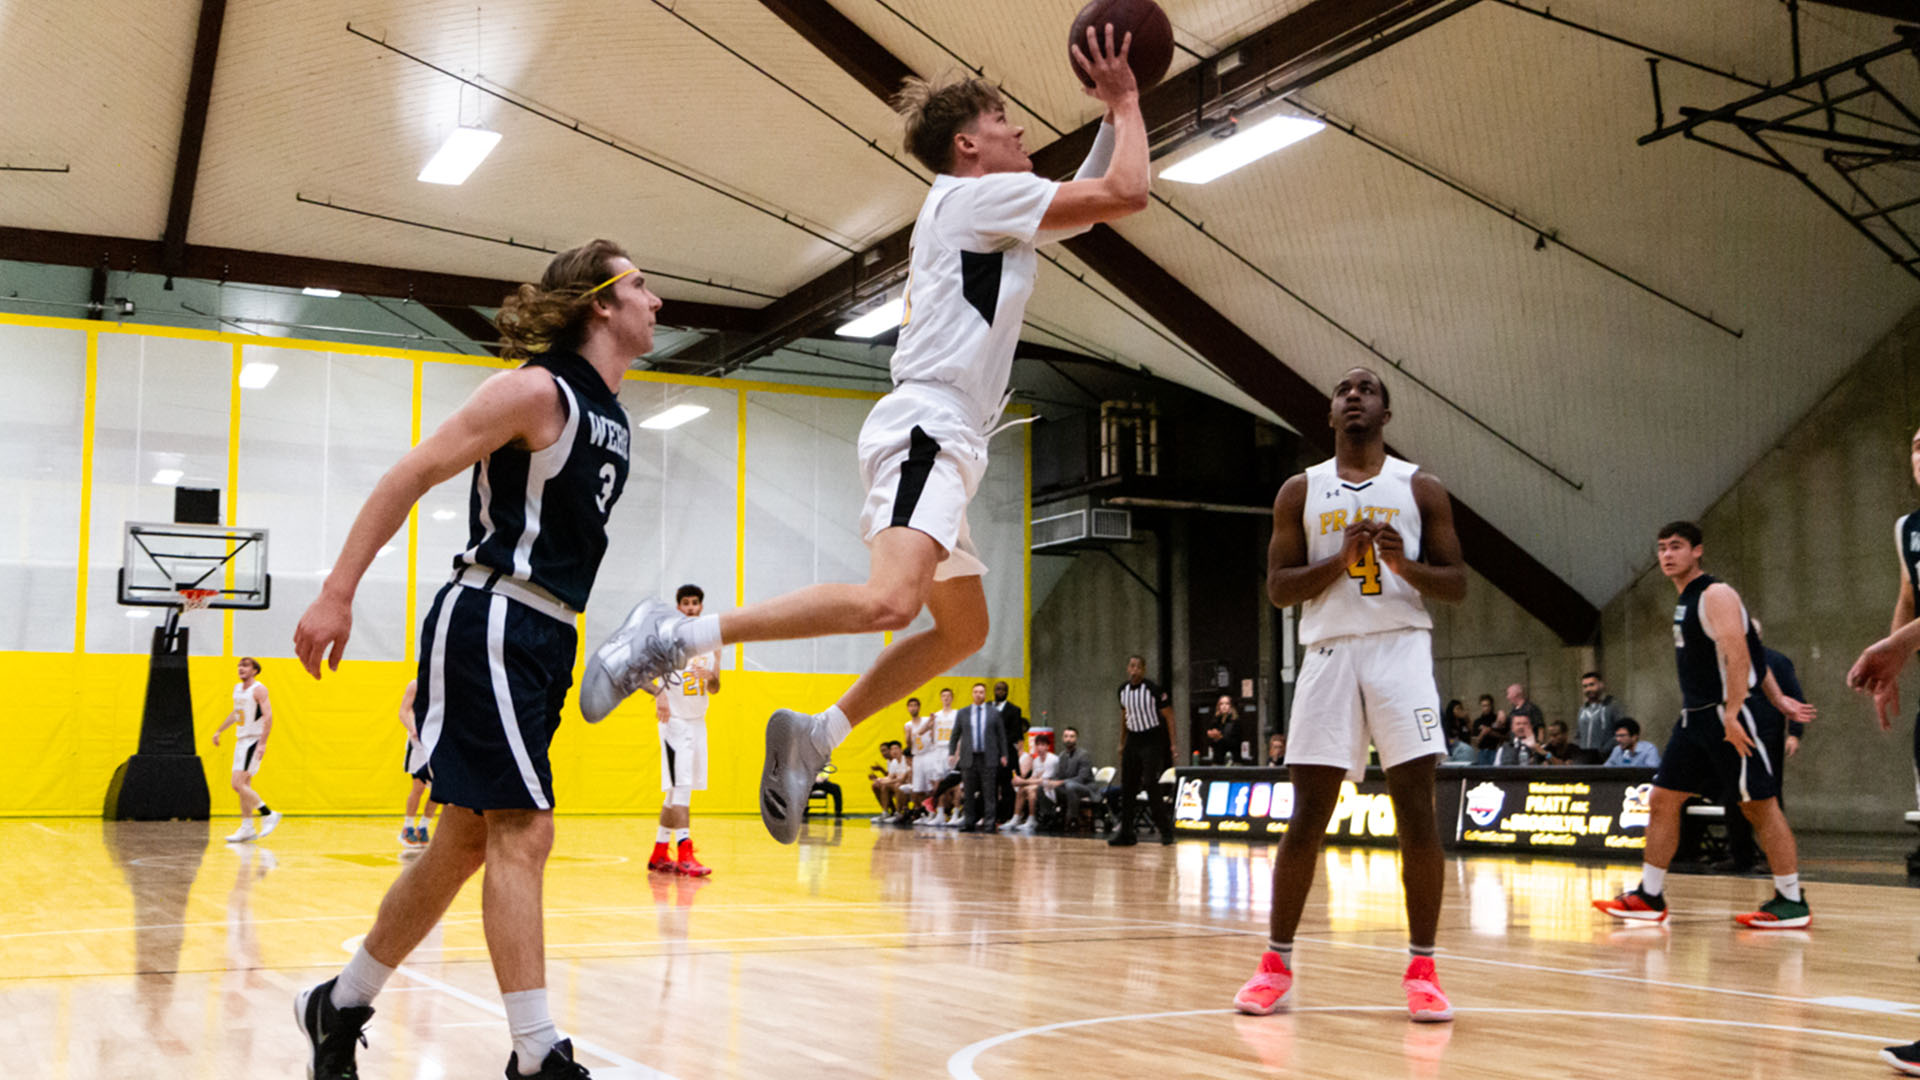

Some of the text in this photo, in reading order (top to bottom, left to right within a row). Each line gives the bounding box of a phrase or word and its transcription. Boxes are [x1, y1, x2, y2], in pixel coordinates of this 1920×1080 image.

[595, 462, 616, 513] 3
[1319, 505, 1400, 535] PRATT
[1346, 541, 1382, 595] 4
[1413, 707, 1439, 742] P
[1325, 780, 1397, 836] Pra
[1525, 795, 1571, 812] PRATT
[1588, 815, 1613, 834] NY
